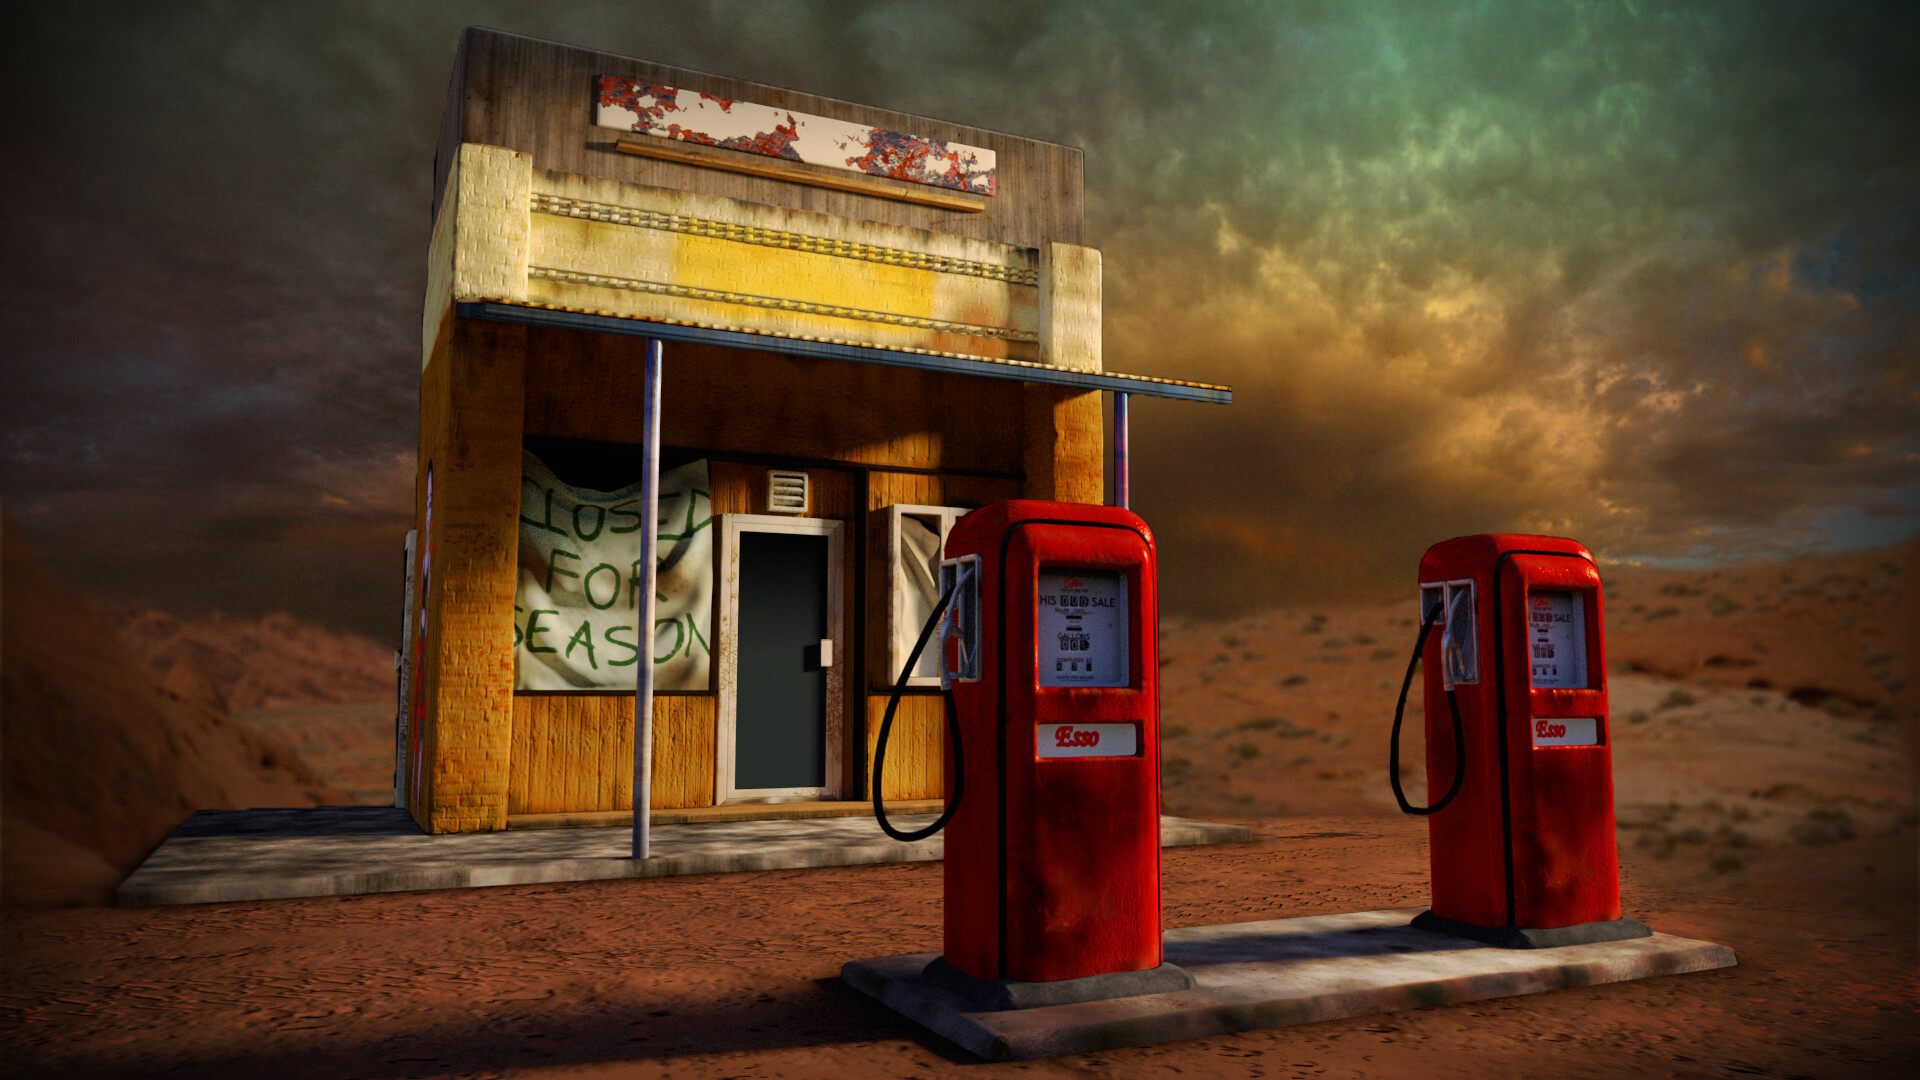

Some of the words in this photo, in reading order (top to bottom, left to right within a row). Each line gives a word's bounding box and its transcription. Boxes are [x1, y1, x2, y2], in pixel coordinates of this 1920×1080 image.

[546, 548, 668, 610] FOR
[1039, 595, 1057, 606] HIS
[1091, 597, 1116, 608] SALE
[1554, 614, 1571, 623] SALE
[1057, 632, 1091, 640] GALLONS
[1055, 725, 1100, 748] Esso
[1536, 720, 1566, 738] Esso
